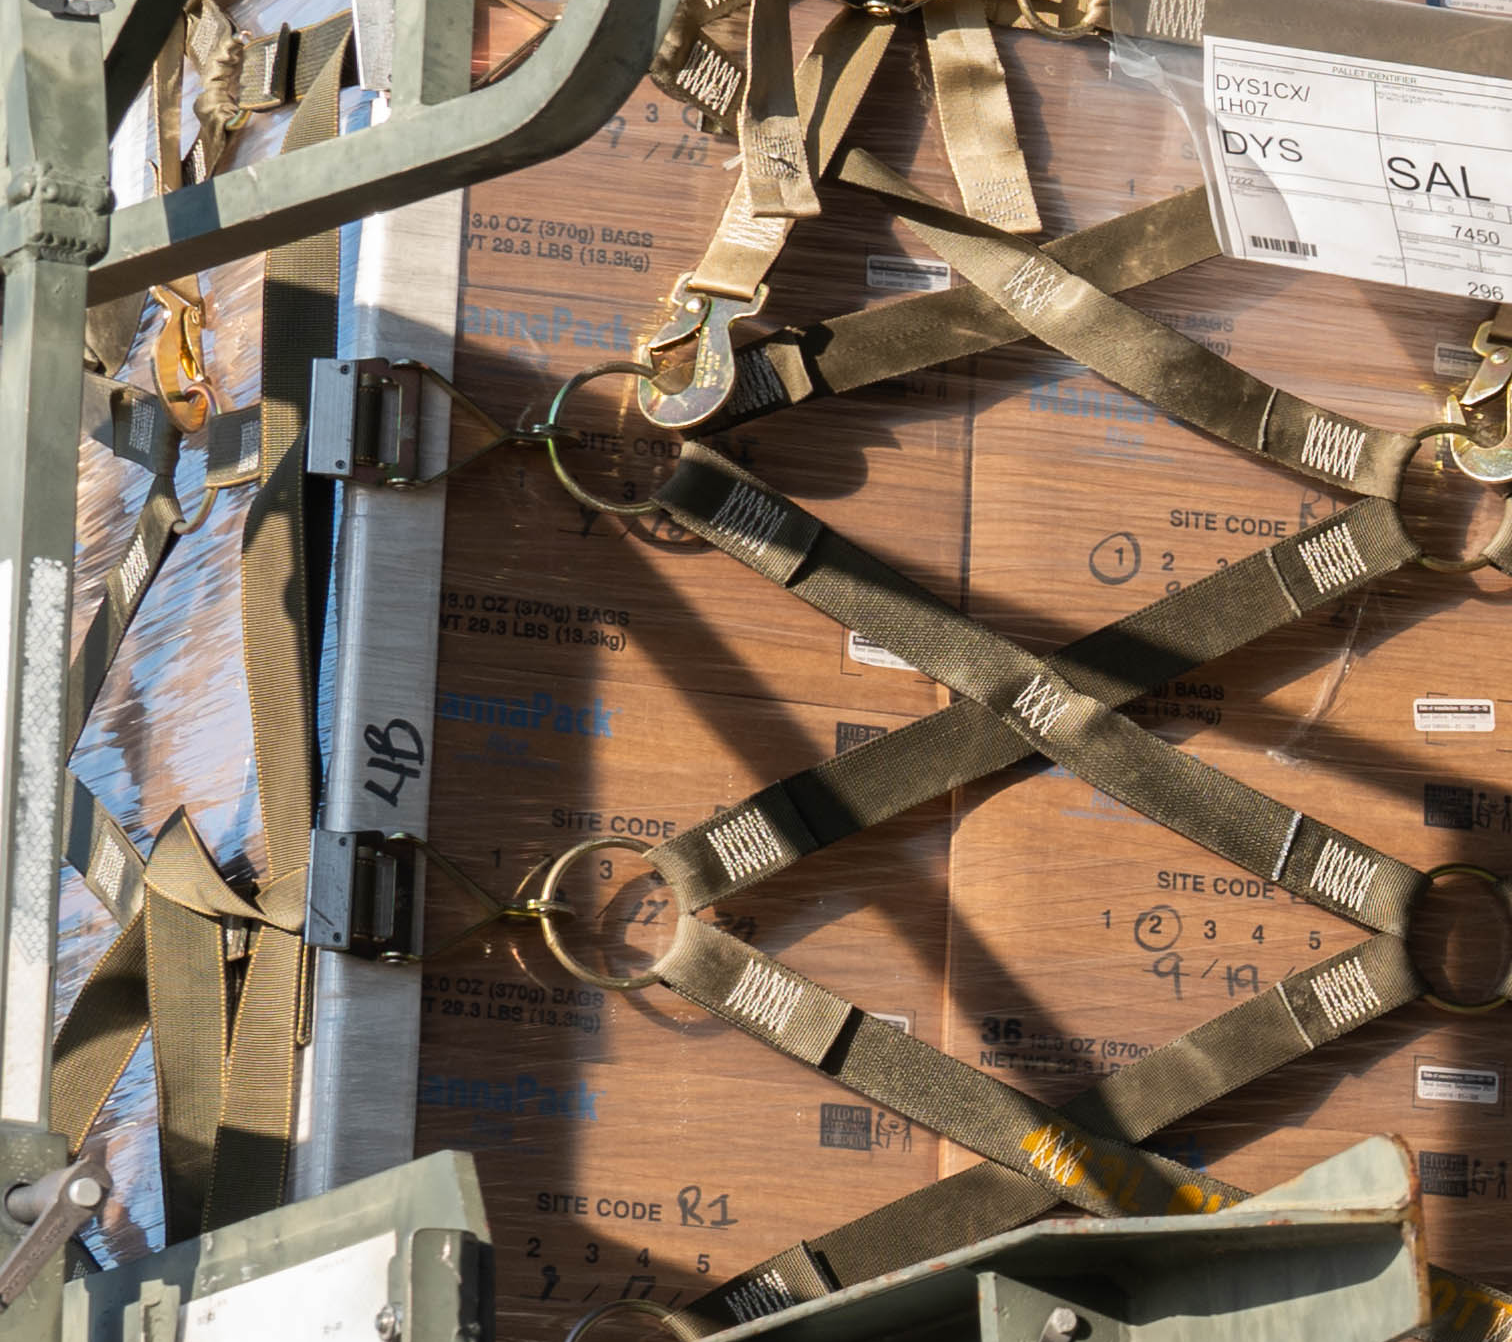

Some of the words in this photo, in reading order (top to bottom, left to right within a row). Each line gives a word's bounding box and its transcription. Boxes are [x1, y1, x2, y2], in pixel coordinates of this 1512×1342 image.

[1216, 74, 1311, 102] DYS1CX/
[1331, 66, 1365, 78] PALLET
[1368, 71, 1417, 85] IDENTIFIER
[1217, 96, 1268, 116] 1H07
[1222, 130, 1303, 162] DYS
[1387, 156, 1491, 202] SAL
[506, 217, 533, 235] OZ
[539, 219, 595, 245] (370g)
[602, 227, 653, 249] BAGS
[1451, 225, 1500, 245] 7450
[494, 236, 531, 256] 29.3
[538, 243, 573, 261] LBS
[580, 247, 651, 272] (13.3kg)
[1467, 281, 1504, 301] 296
[462, 304, 632, 352] annaPack
[1170, 509, 1217, 530] SITE
[1225, 516, 1287, 538] CODE
[1162, 553, 1175, 571] 2
[481, 597, 509, 612] OZ
[577, 610, 630, 626] BAGS
[468, 617, 506, 635] 29.3
[513, 622, 550, 640] LBS
[555, 625, 627, 652] (13.3kg)
[440, 692, 613, 739] annaPack
[364, 717, 425, 808] 4B
[551, 809, 602, 833] SITE
[611, 815, 676, 840] CODE
[601, 859, 613, 880] 3
[1157, 870, 1205, 893] SITE
[1212, 877, 1275, 901] CODE
[1101, 909, 1112, 930] 1
[1149, 914, 1163, 934] 2
[1203, 920, 1217, 941] 3
[1252, 925, 1266, 945] 4
[1308, 930, 1322, 951] 5
[981, 1016, 1023, 1047] 36
[1070, 1036, 1096, 1055] OZ
[422, 1074, 600, 1122] annaPack
[536, 1192, 588, 1216] SITE
[596, 1198, 662, 1223] CODE
[526, 1237, 542, 1257] 2
[585, 1242, 598, 1264] 3
[636, 1247, 650, 1268] 4
[696, 1253, 711, 1274] 5
